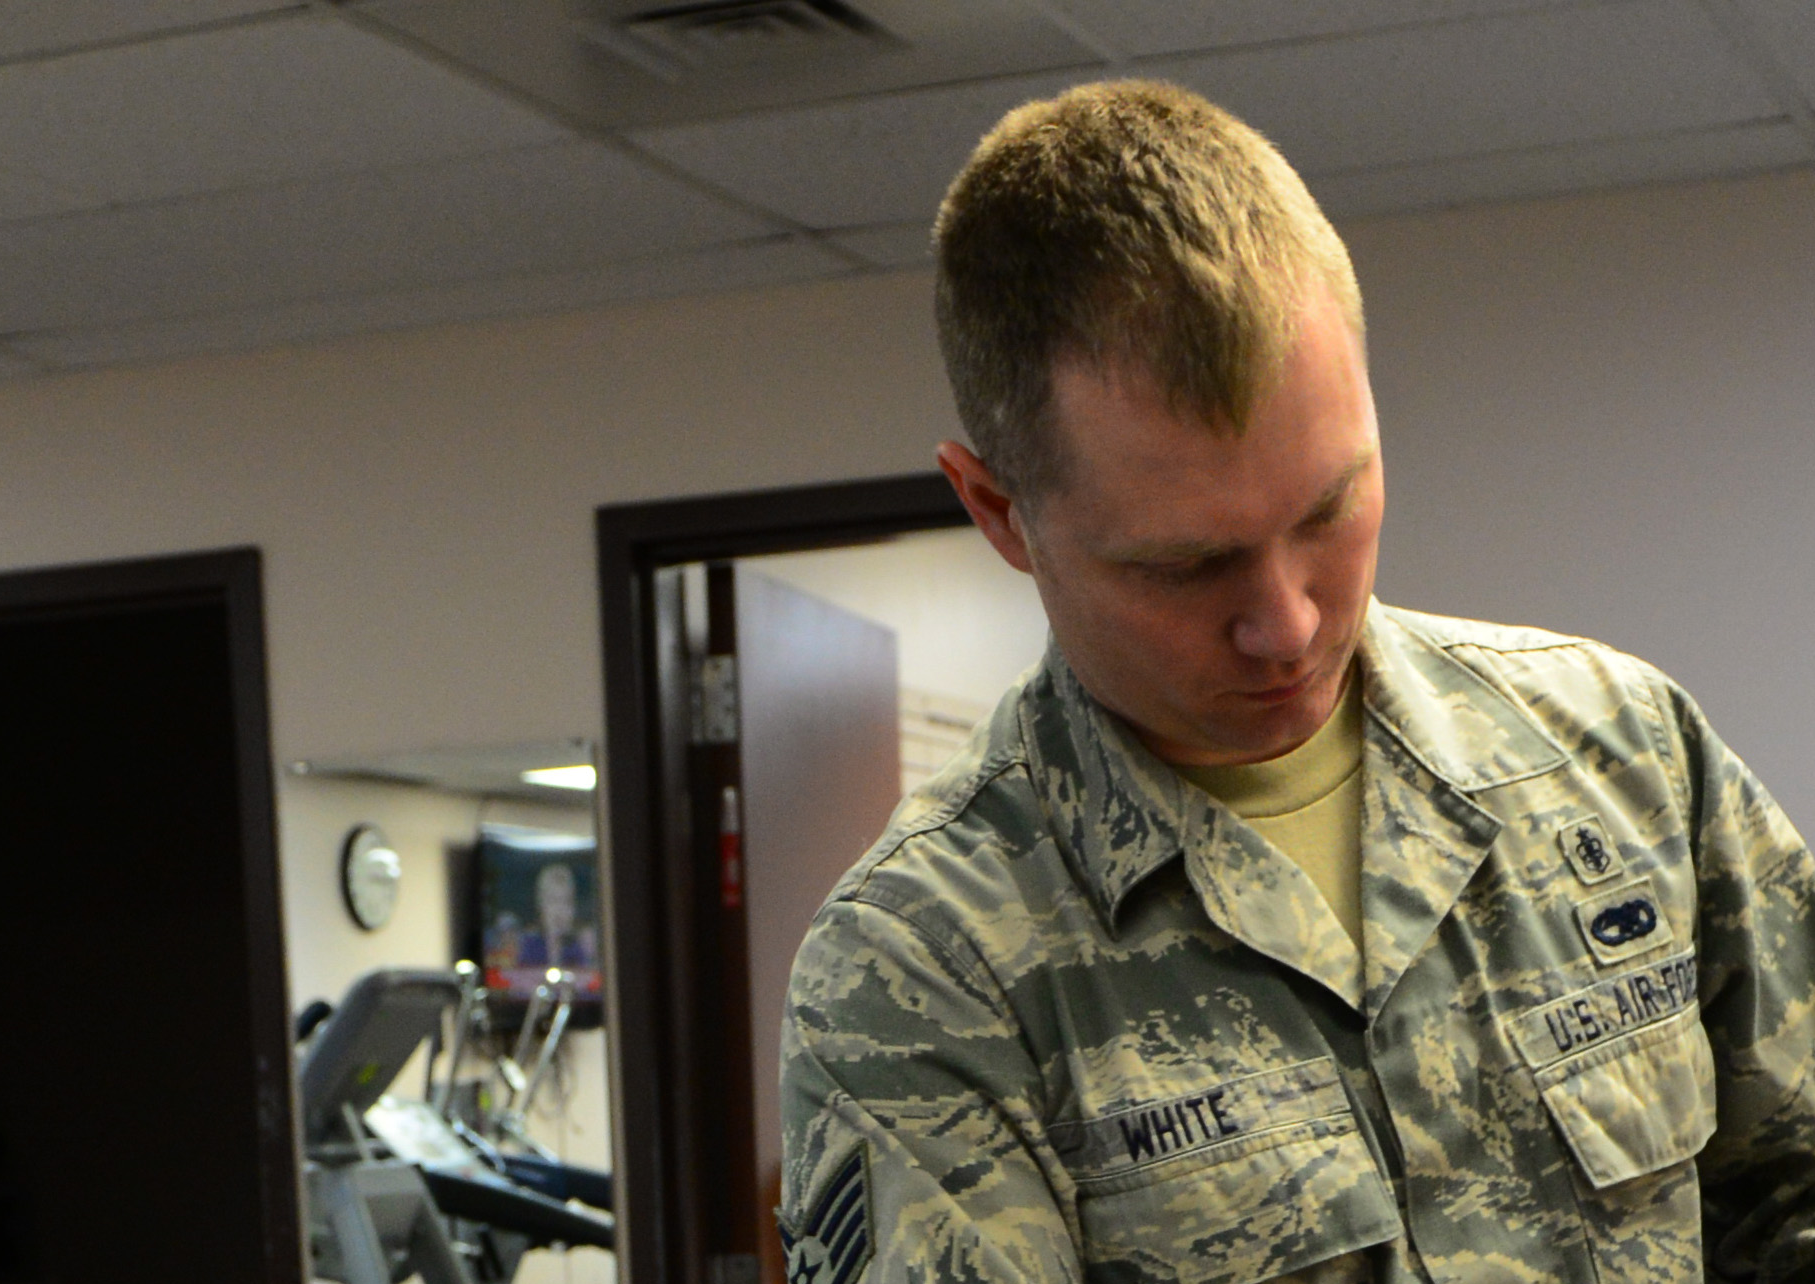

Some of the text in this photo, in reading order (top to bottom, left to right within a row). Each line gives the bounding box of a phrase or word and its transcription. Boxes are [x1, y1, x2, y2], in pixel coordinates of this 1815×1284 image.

[1545, 1000, 1610, 1052] U.S.
[1613, 975, 1660, 1026] AIR
[1119, 1090, 1238, 1163] WHITE
